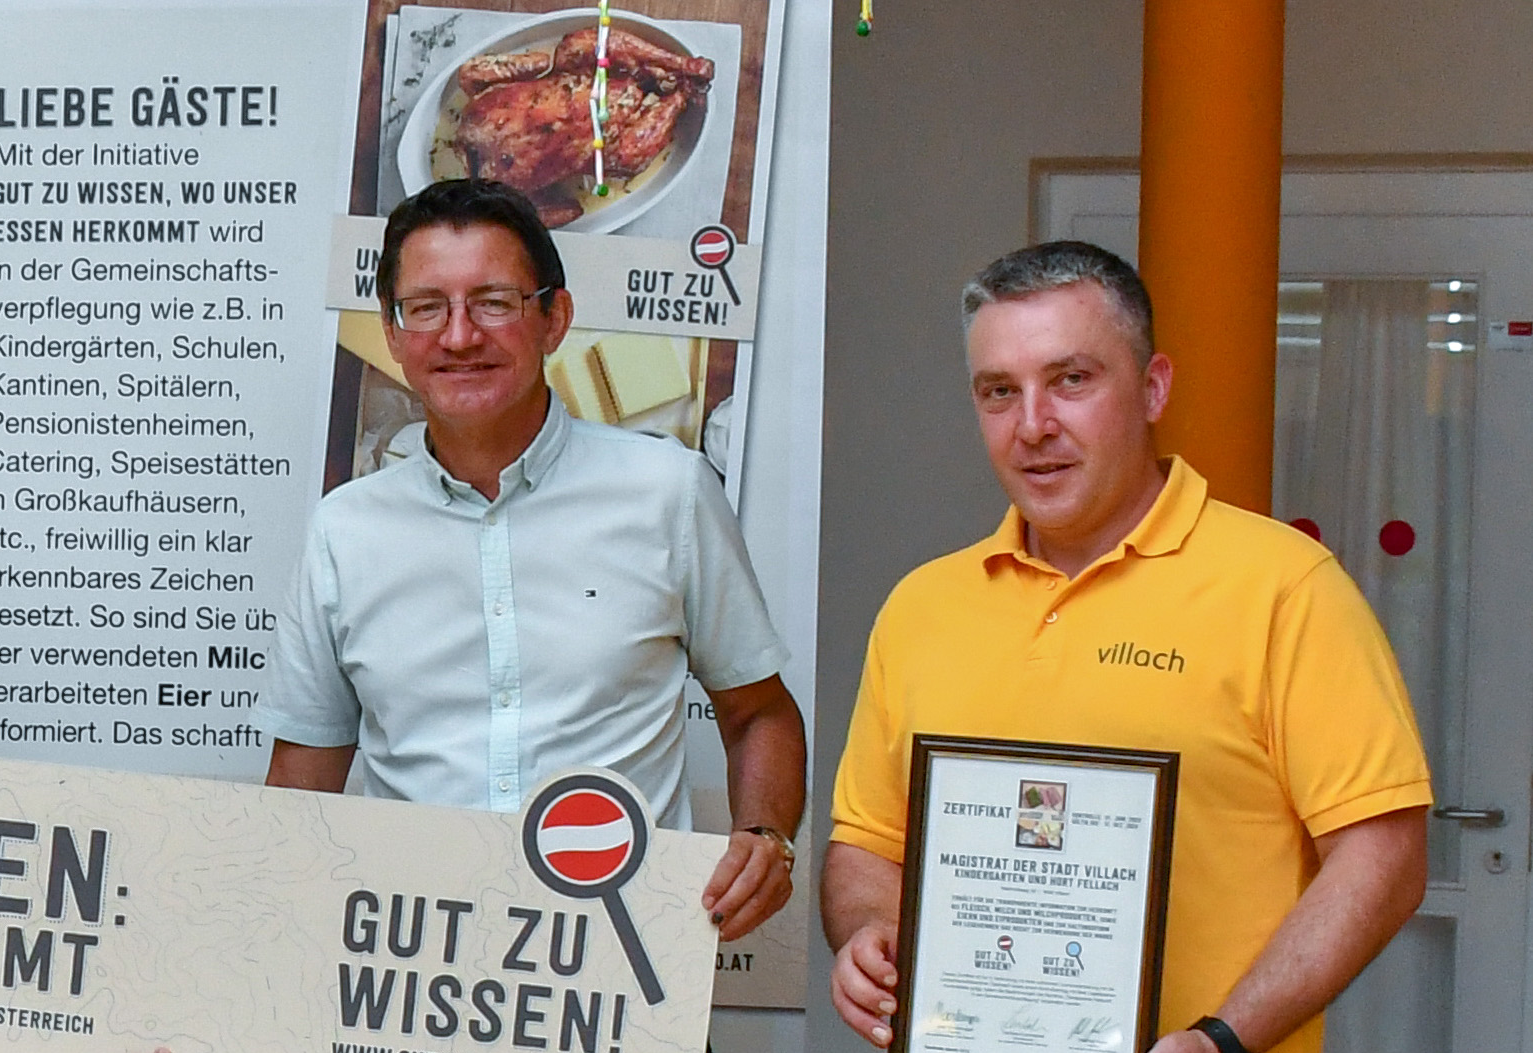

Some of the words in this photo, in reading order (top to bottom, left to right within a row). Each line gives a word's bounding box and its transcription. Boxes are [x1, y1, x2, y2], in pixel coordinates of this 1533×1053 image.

[131, 76, 278, 127] GÄSTE!
[42, 143, 84, 166] der
[93, 143, 200, 166] Initiative
[42, 182, 68, 205] ZU
[77, 182, 173, 207] WISSEN,
[181, 182, 215, 205] WO
[224, 181, 298, 205] UNSER
[72, 220, 200, 243] HERKOMMT
[209, 220, 264, 243] wird
[20, 258, 63, 281] der
[71, 257, 279, 282] Gemeinschafts-
[627, 269, 673, 295] GUT
[684, 272, 714, 298] ZU
[150, 298, 194, 320] wie
[202, 298, 252, 320] z.B.
[262, 298, 284, 320] in
[626, 295, 728, 327] WISSEN!
[172, 335, 286, 363] Schulen,
[117, 374, 241, 402] Spitälern,
[110, 451, 292, 479] Speisestätten
[14, 487, 246, 518] Großkaufhäusern,
[45, 527, 149, 557] freiwillig
[158, 529, 196, 552] ein
[205, 530, 253, 553] klar
[150, 567, 254, 592] Zeichen
[90, 604, 125, 628] So
[132, 606, 187, 631] sind
[195, 606, 236, 631] Sie
[29, 645, 198, 669] verwendeten
[208, 647, 270, 670] Milc
[1098, 642, 1185, 673] villach
[157, 683, 212, 707] Eier
[112, 721, 162, 746] Das
[171, 723, 263, 748] schafft
[943, 802, 1012, 819] ZERTIFIKAT
[940, 853, 1009, 870] MAGISTRAT
[1013, 859, 1037, 873] DER
[1041, 861, 1080, 876] STADT
[1084, 865, 1137, 882] VILLACH
[954, 868, 1026, 883] KINDERGARTEN
[1028, 875, 1046, 885] UND
[1050, 876, 1073, 887] HORT
[1077, 879, 1120, 892] FELLACH
[342, 889, 474, 964] GUT
[501, 906, 589, 978] ZU
[974, 960, 1012, 971] WISSEN!
[975, 950, 991, 960] GUT
[995, 951, 1007, 961] ZU
[1043, 956, 1059, 967] GUT
[1063, 958, 1075, 968] ZU
[1042, 967, 1080, 977] WISSEN!
